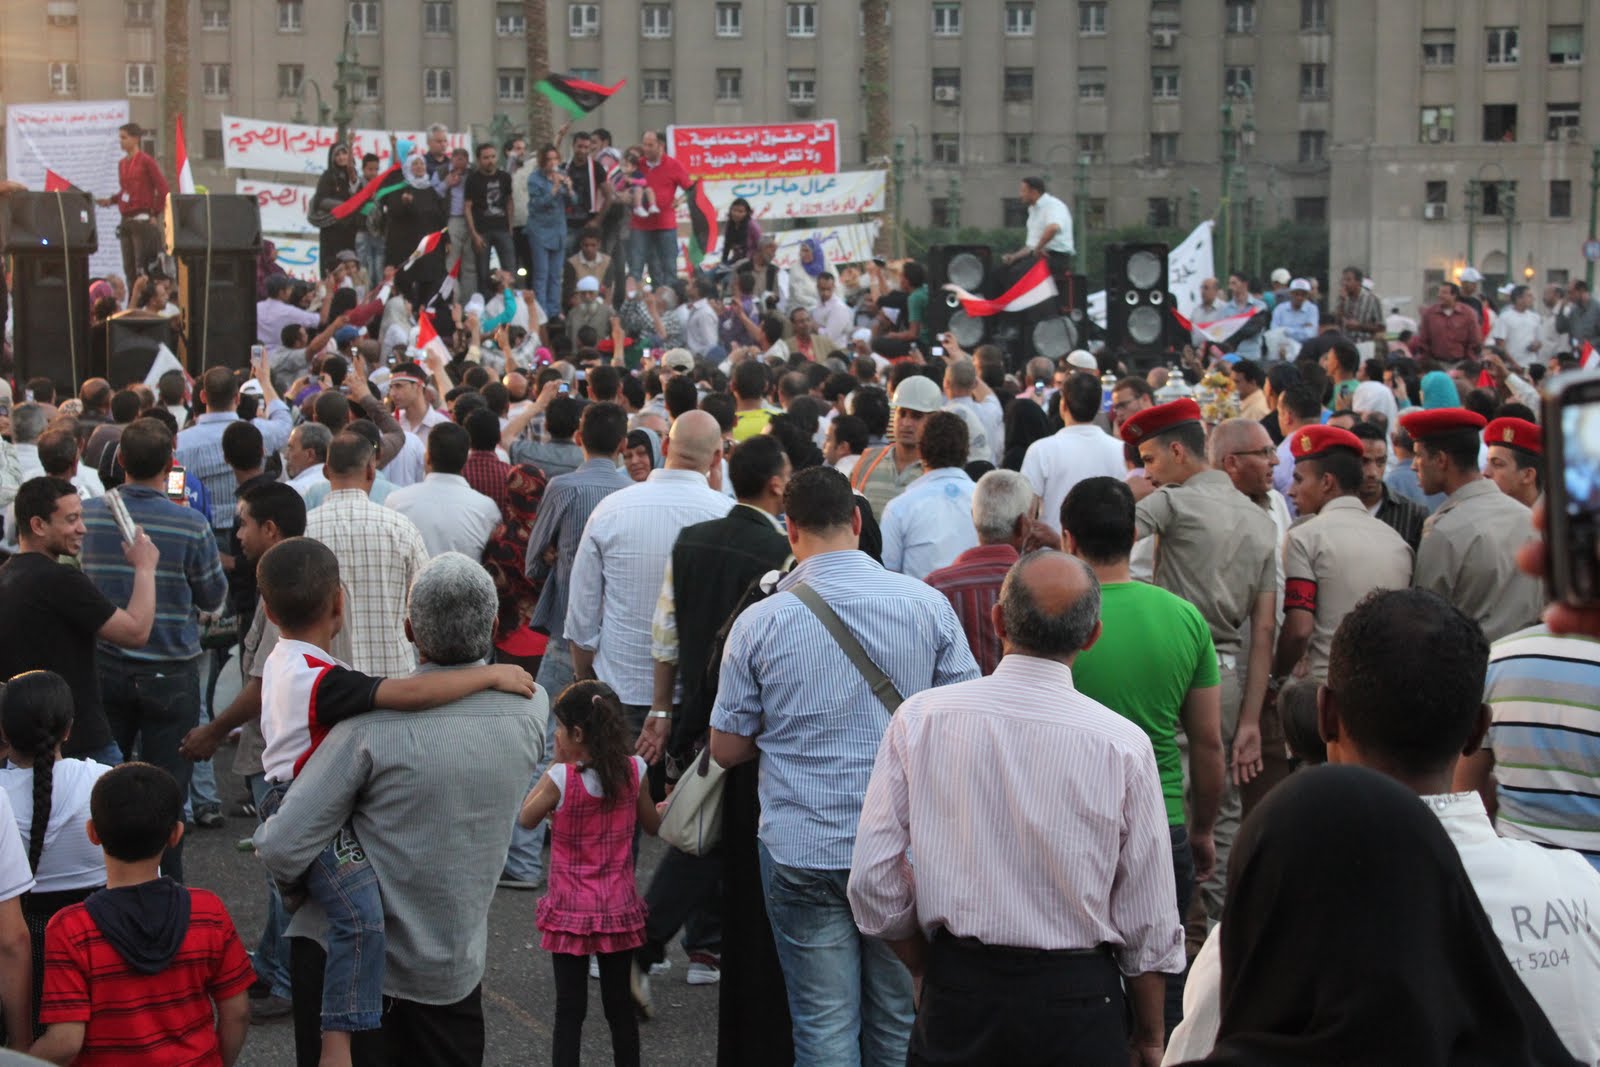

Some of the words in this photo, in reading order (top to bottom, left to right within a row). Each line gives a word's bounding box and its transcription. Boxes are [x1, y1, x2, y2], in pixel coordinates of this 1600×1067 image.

[690, 131, 759, 150] اجتماعية
[761, 129, 806, 147] حقوق
[738, 151, 778, 168] مطالب
[804, 149, 821, 165] ولا
[801, 177, 837, 197] عمال
[1511, 898, 1593, 943] RAW
[1528, 947, 1570, 971] 5204
